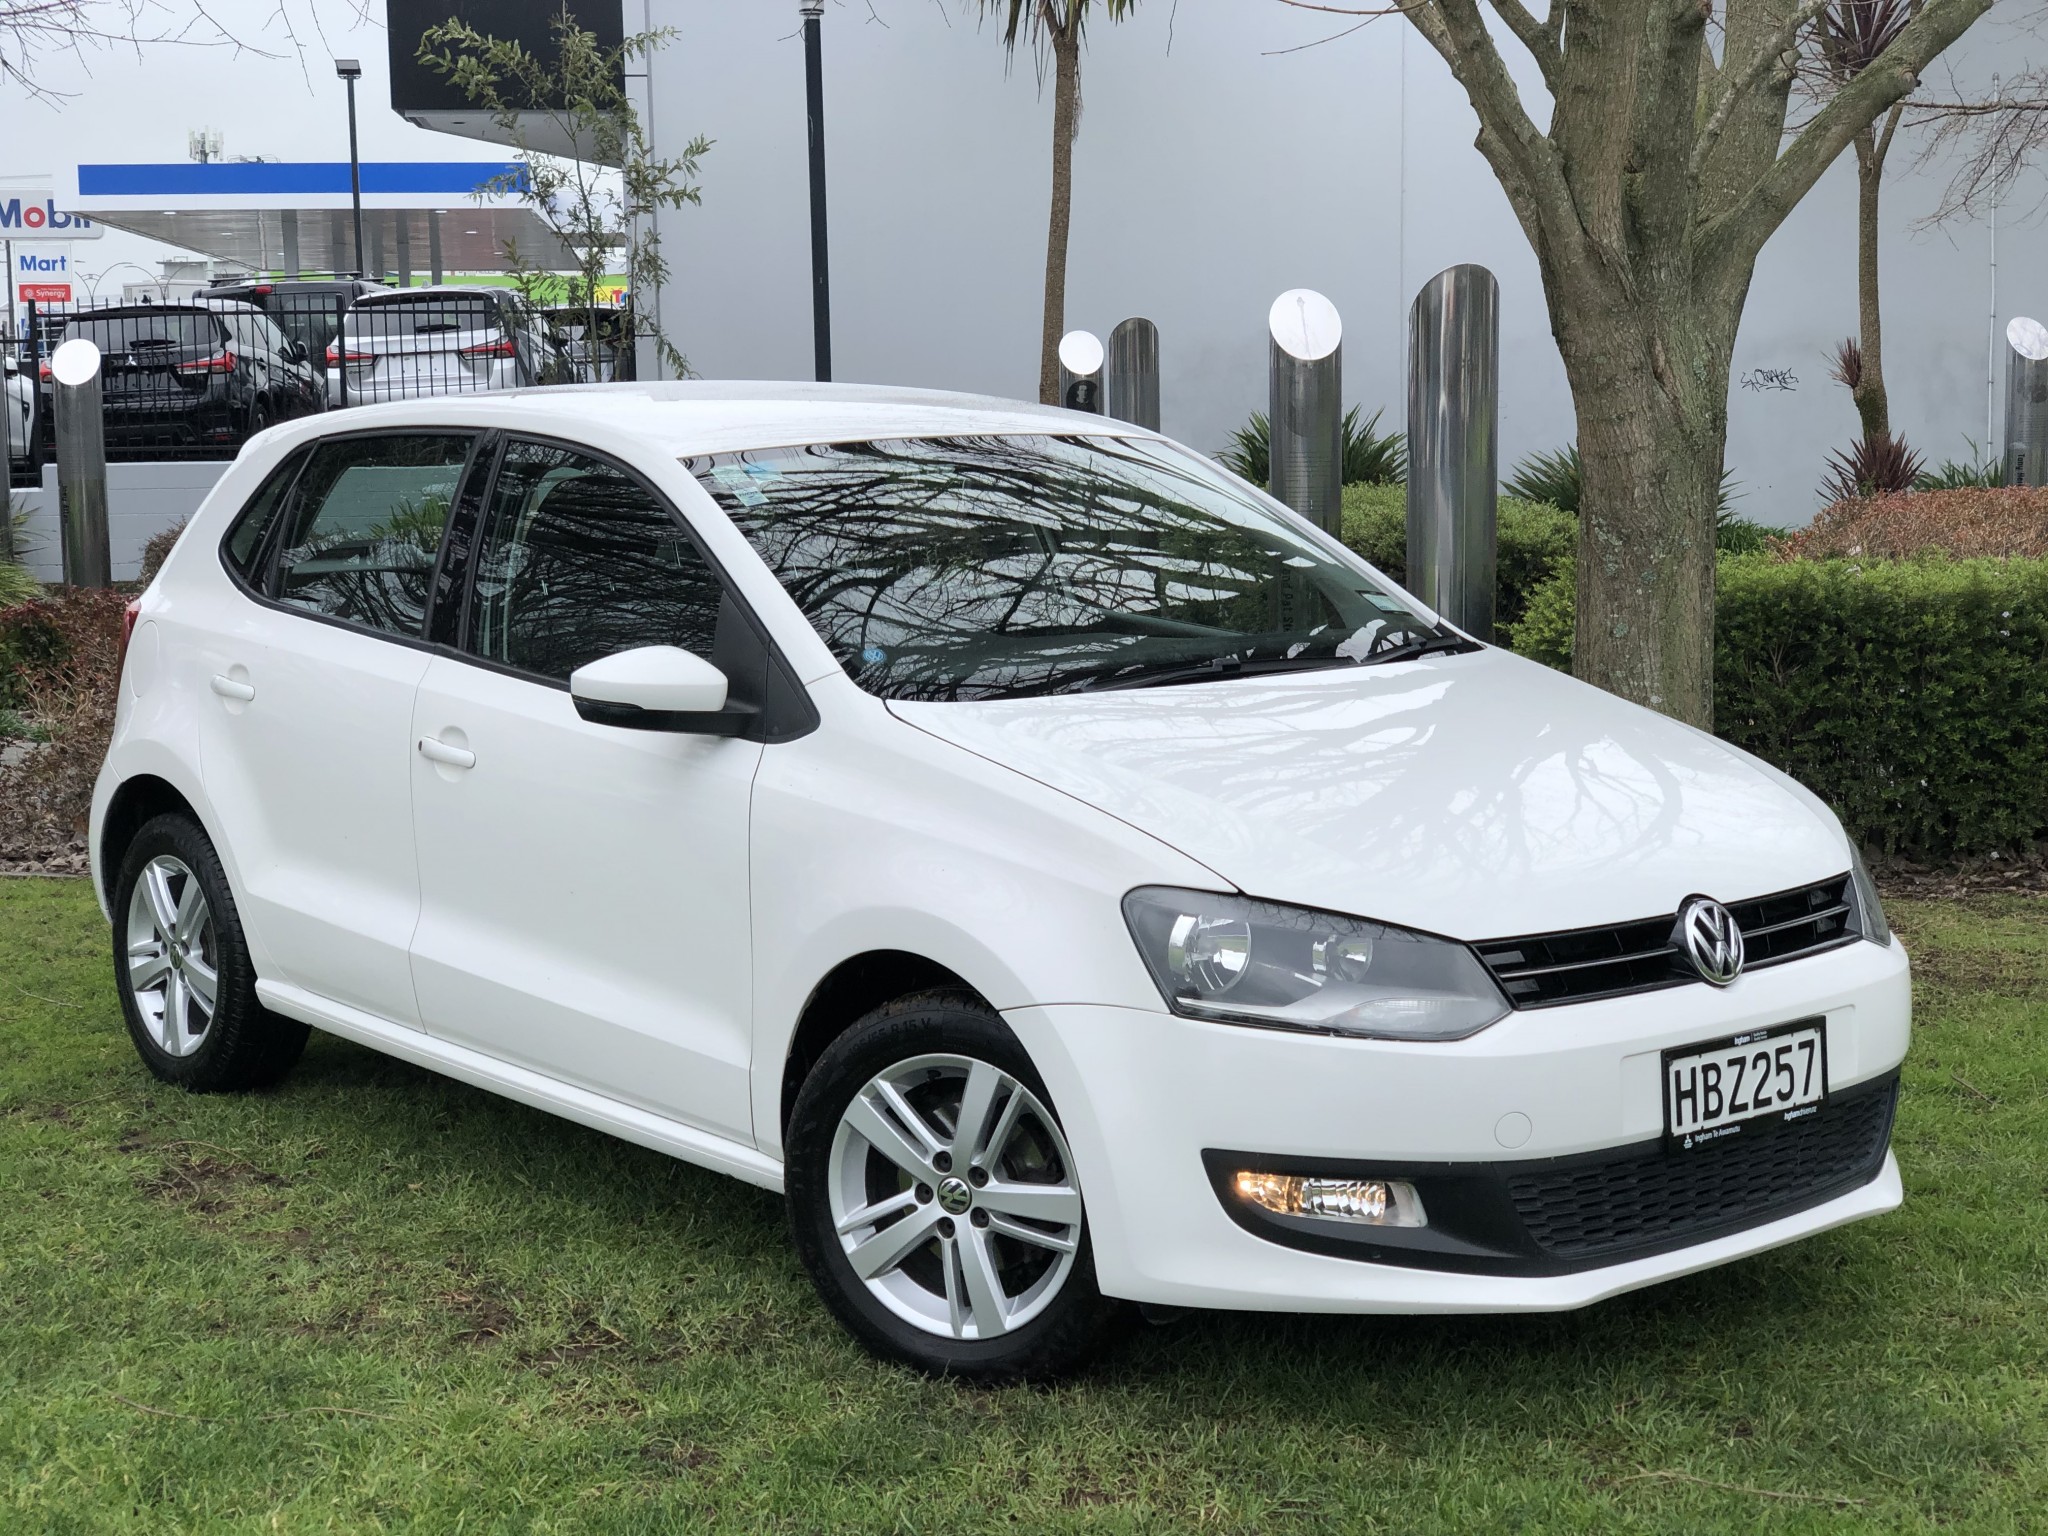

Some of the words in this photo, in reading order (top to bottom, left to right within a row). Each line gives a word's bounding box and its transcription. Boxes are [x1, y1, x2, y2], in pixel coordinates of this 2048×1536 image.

[20, 255, 67, 271] Mart
[36, 289, 66, 299] Synergy
[1675, 1039, 1815, 1127] HBZ257
